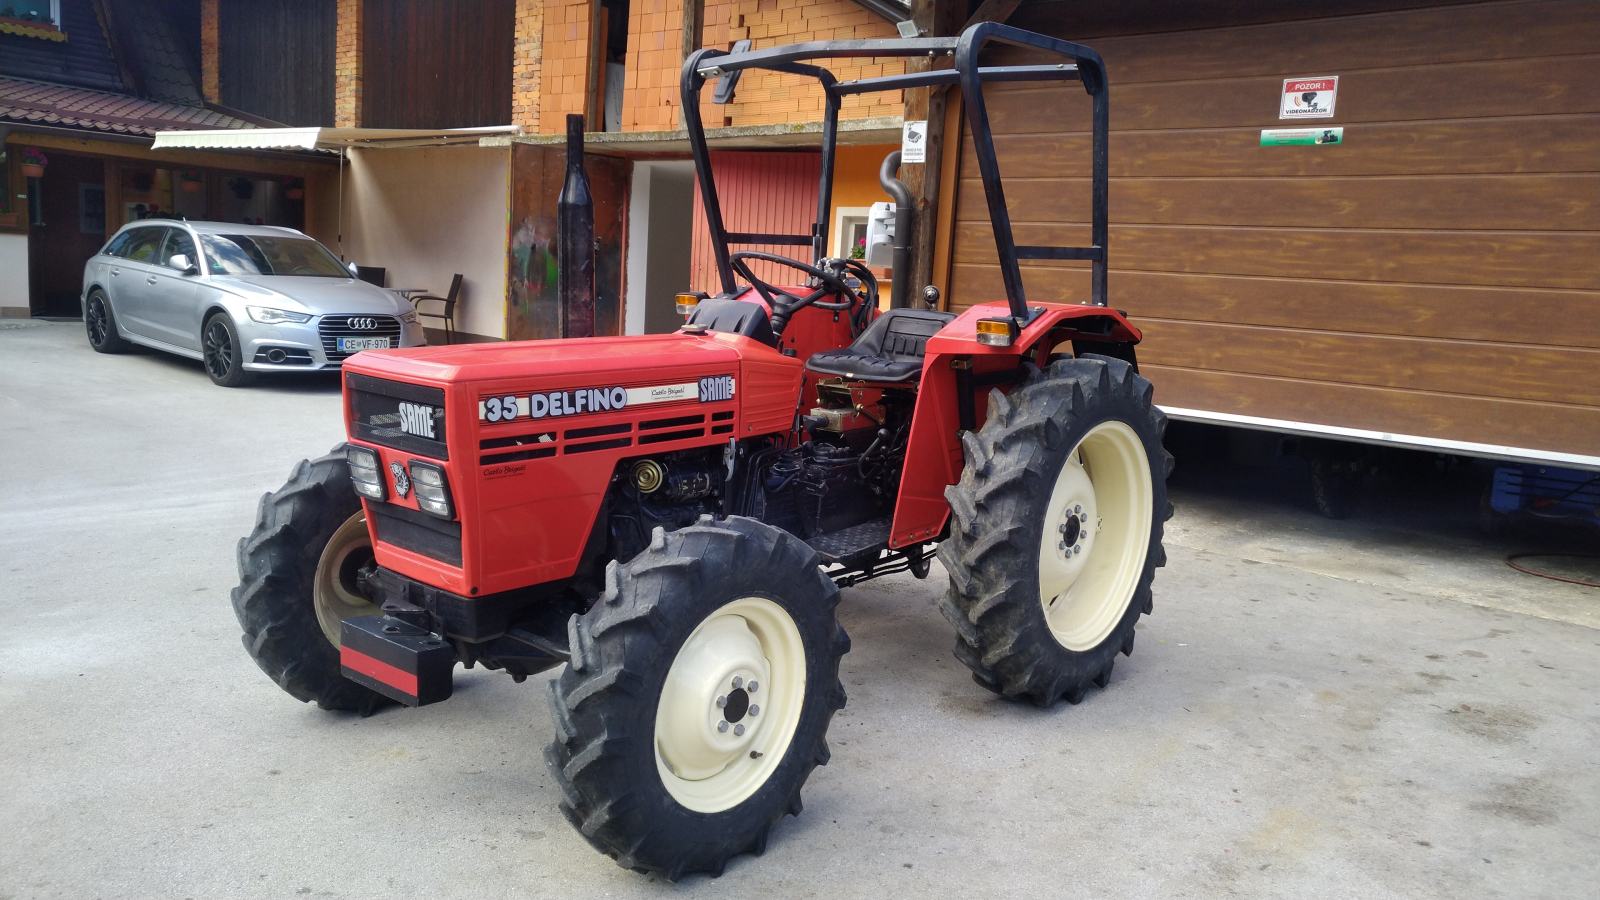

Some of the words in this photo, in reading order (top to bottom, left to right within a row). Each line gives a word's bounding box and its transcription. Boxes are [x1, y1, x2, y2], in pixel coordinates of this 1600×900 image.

[344, 340, 356, 349] CE
[362, 340, 388, 349] VF-970
[485, 396, 518, 422] 35
[530, 386, 628, 418] DELFINO
[699, 376, 733, 402] SAME
[399, 402, 435, 438] SAME
